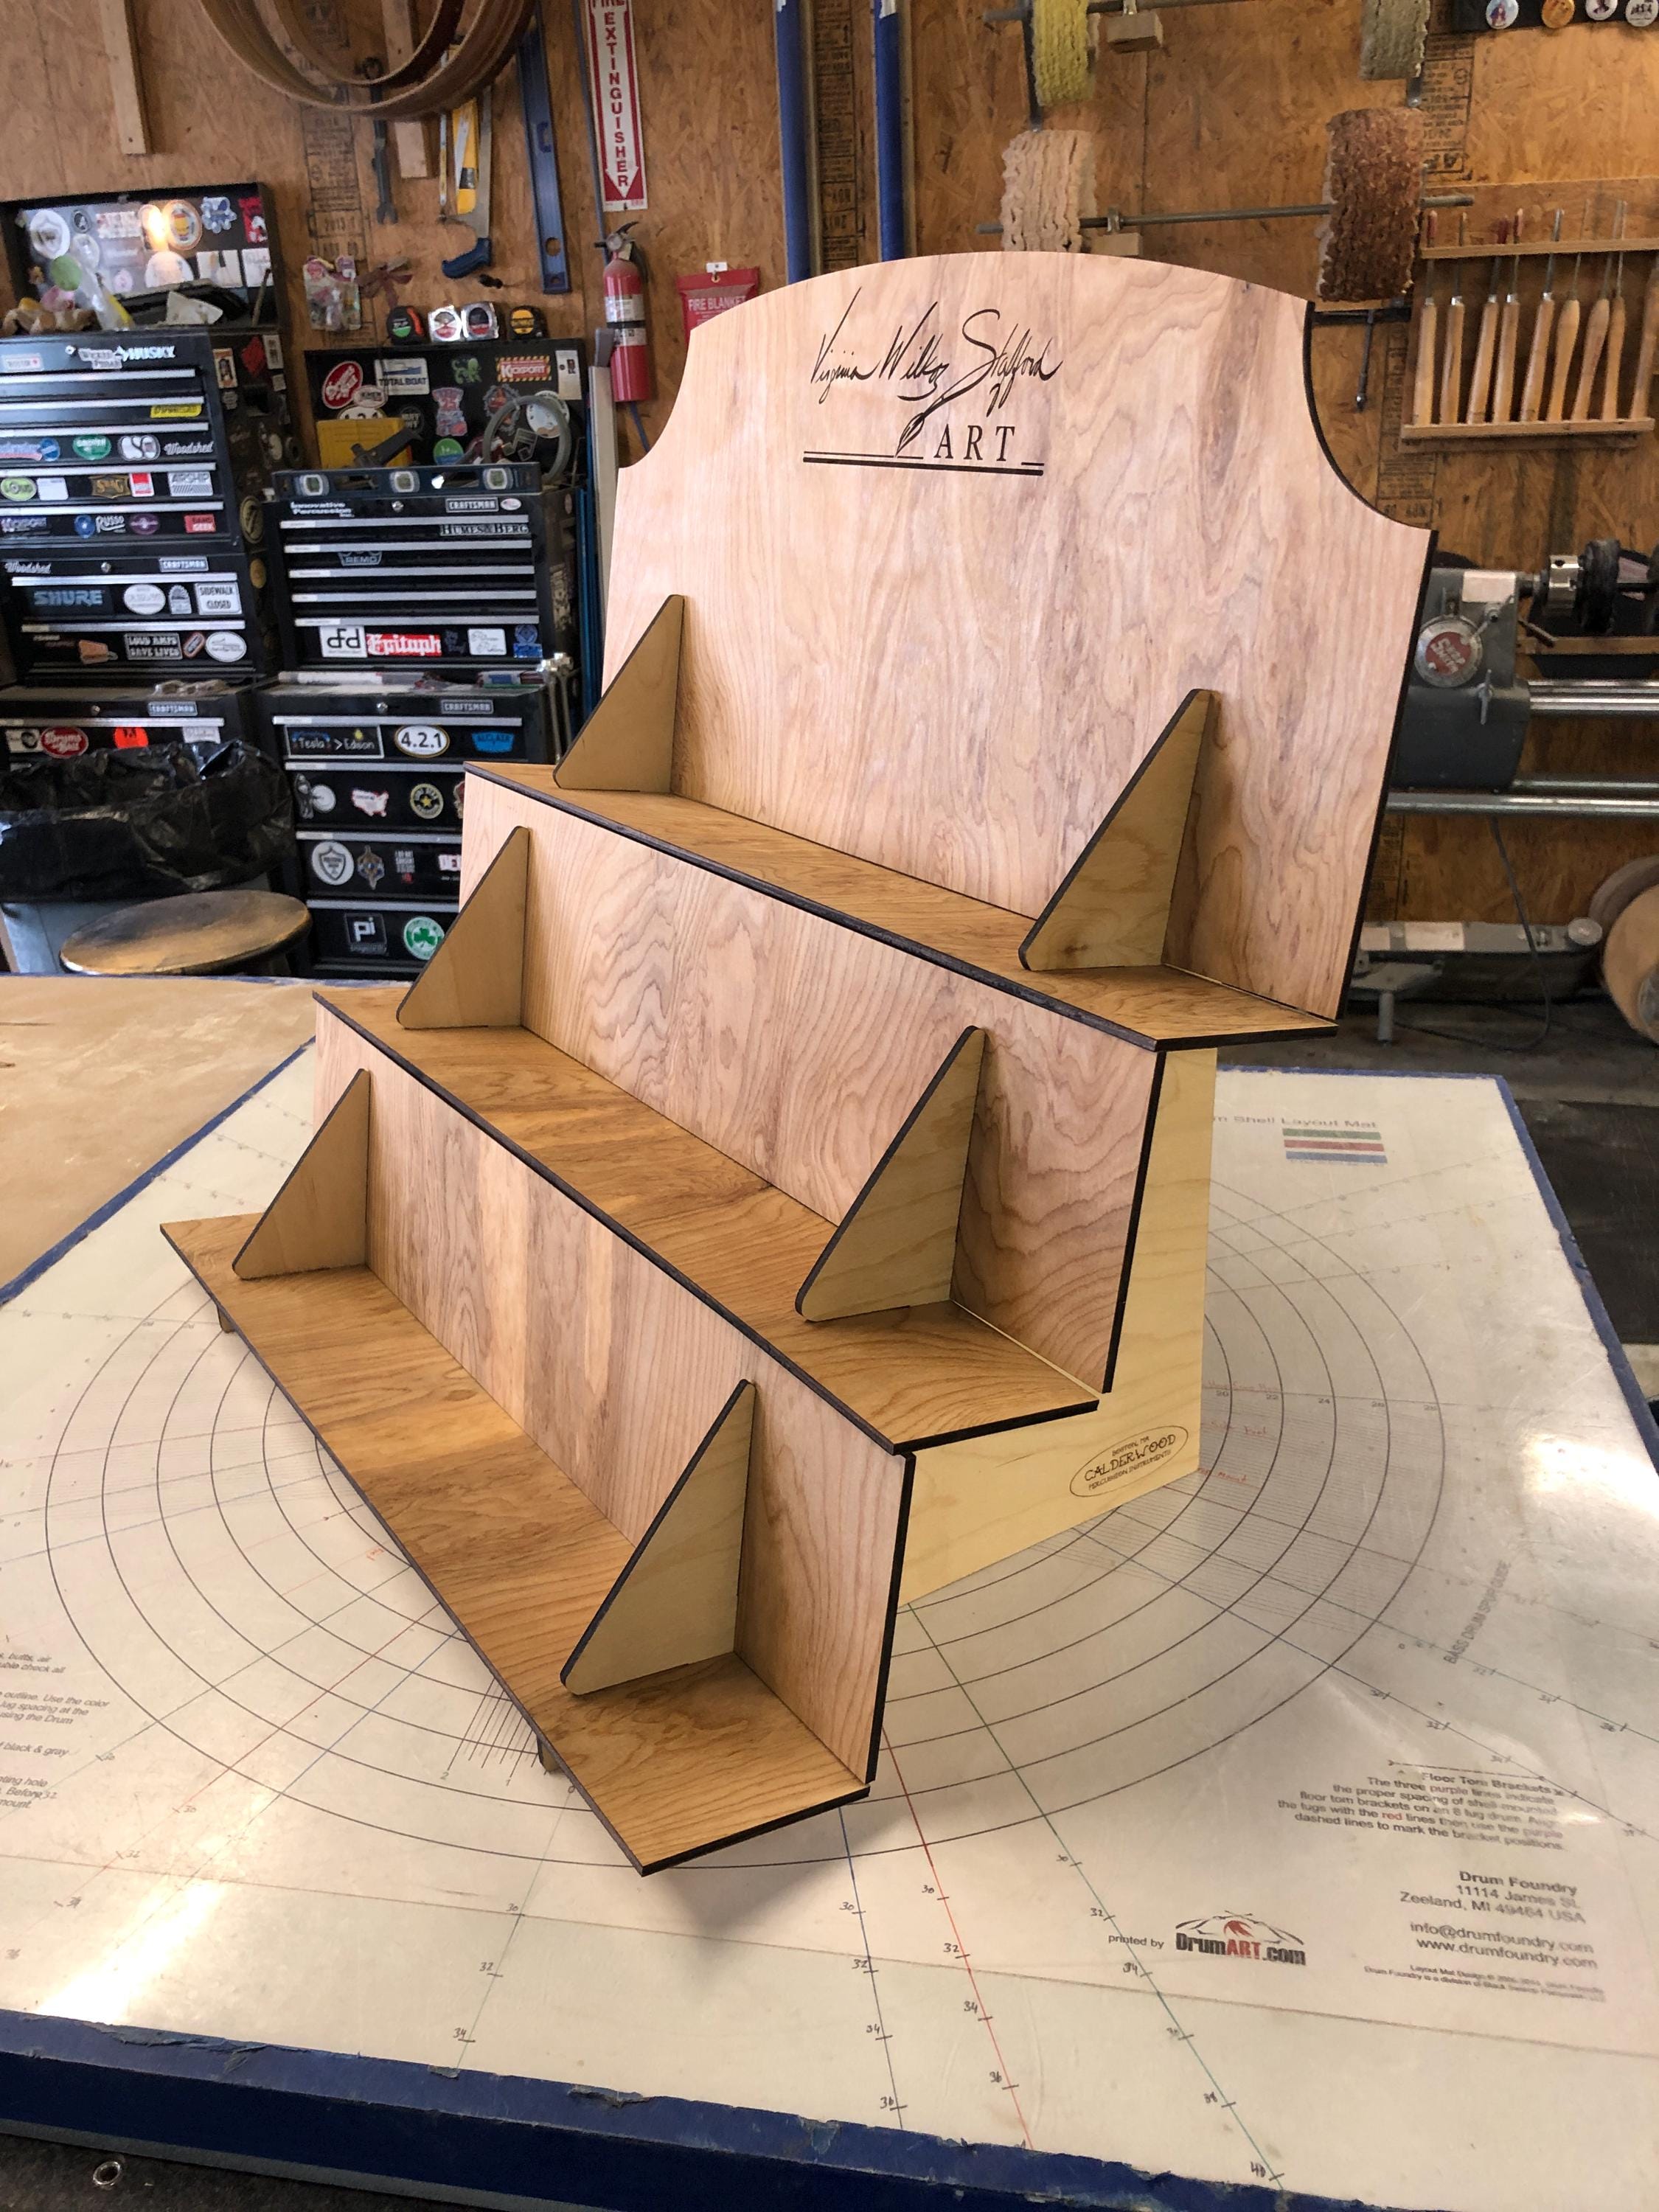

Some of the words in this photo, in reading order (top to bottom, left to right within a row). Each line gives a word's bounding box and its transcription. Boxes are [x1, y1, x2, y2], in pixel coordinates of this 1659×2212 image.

[603, 12, 628, 187] EXTINGUISHER
[688, 298, 706, 310] FIRE
[127, 346, 175, 360] HUSKY
[933, 423, 1015, 462] ART
[449, 501, 496, 509] CRAFTSMAN
[34, 590, 103, 606] SHURE
[199, 586, 234, 596] SIDEWALK
[1234, 1116, 1275, 1124] Shell
[1281, 1117, 1338, 1127] Layout
[1345, 1120, 1378, 1128] Mat
[1084, 1433, 1176, 1481] CALDERWOOD
[1444, 1639, 1469, 1663] BASS
[44, 1714, 74, 1725] Drum
[3, 1742, 33, 1753] black
[44, 1747, 70, 1758] gray
[440, 1771, 449, 1780] 2
[1332, 1784, 1353, 1795] the
[1355, 1787, 1396, 1799] proper
[1452, 1796, 1464, 1806] of
[1367, 1776, 1391, 1787] The
[1394, 1779, 1426, 1791] three
[1429, 1784, 1469, 1797] purple
[1277, 1799, 1298, 1809] the
[1301, 1802, 1326, 1814] lugs
[1329, 1805, 1355, 1816] with
[1359, 1808, 1379, 1818] the
[1381, 1811, 1404, 1821] red
[1405, 1812, 1436, 1825] lines
[1300, 1790, 1326, 1802] floor
[1329, 1794, 1354, 1805] tom
[1357, 1798, 1411, 1812] brackets
[1413, 1804, 1430, 1813] on
[1294, 1812, 1341, 1825] dashed
[1344, 1816, 1374, 1829] lines
[1377, 1820, 1390, 1831] to
[1393, 1823, 1426, 1835] mark
[1428, 1826, 1450, 1837] the
[1459, 1871, 1504, 1885] Drum
[1509, 1876, 1578, 1896] Foundry
[1505, 1891, 1557, 1907] James
[1472, 1900, 1491, 1912] MI
[1548, 1909, 1587, 1924] USA
[1108, 1933, 1147, 1947] printed
[1150, 1937, 1165, 1950] by
[1175, 1932, 1307, 1966] DrumART.com
